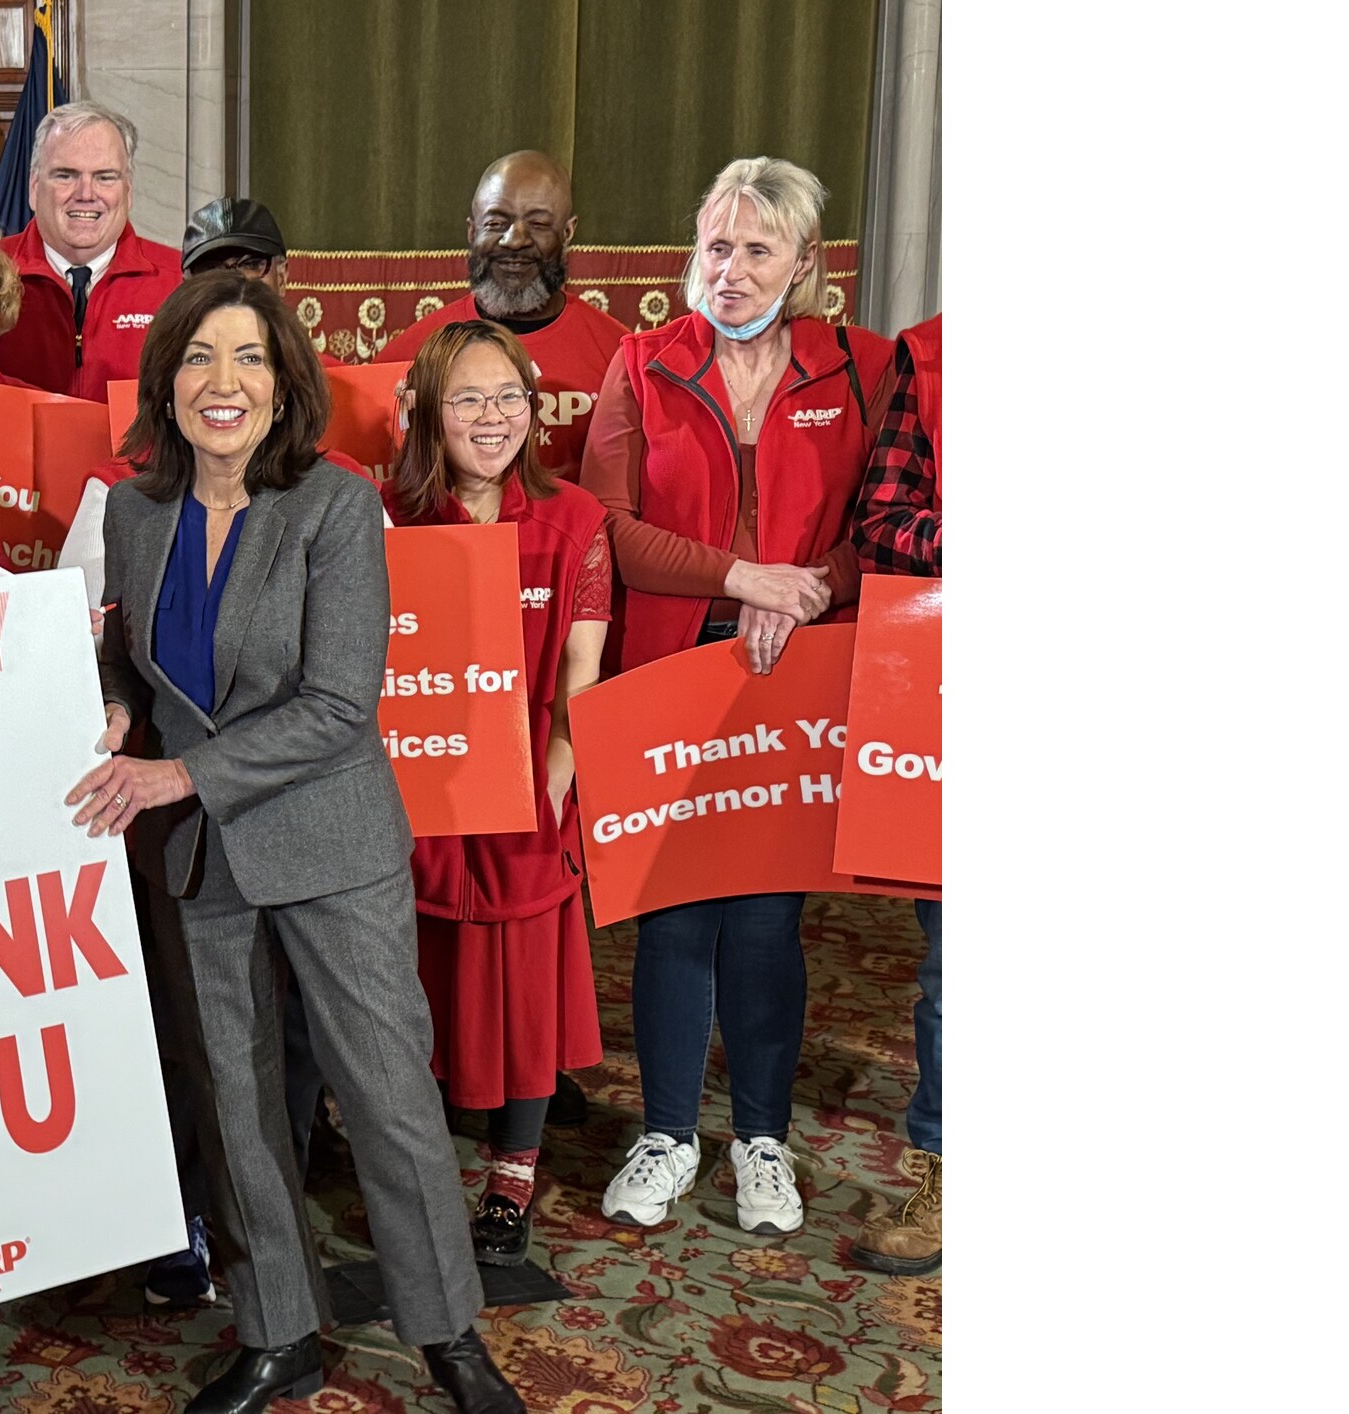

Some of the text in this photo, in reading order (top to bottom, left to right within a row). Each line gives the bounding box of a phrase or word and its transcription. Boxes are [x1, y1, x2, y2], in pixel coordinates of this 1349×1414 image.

[112, 313, 154, 325] AARP
[787, 407, 842, 421] AARP
[530, 601, 545, 609] York
[380, 664, 519, 697] ists for
[644, 723, 787, 776] Thank
[857, 741, 943, 782] Gov
[592, 782, 789, 844] Governor
